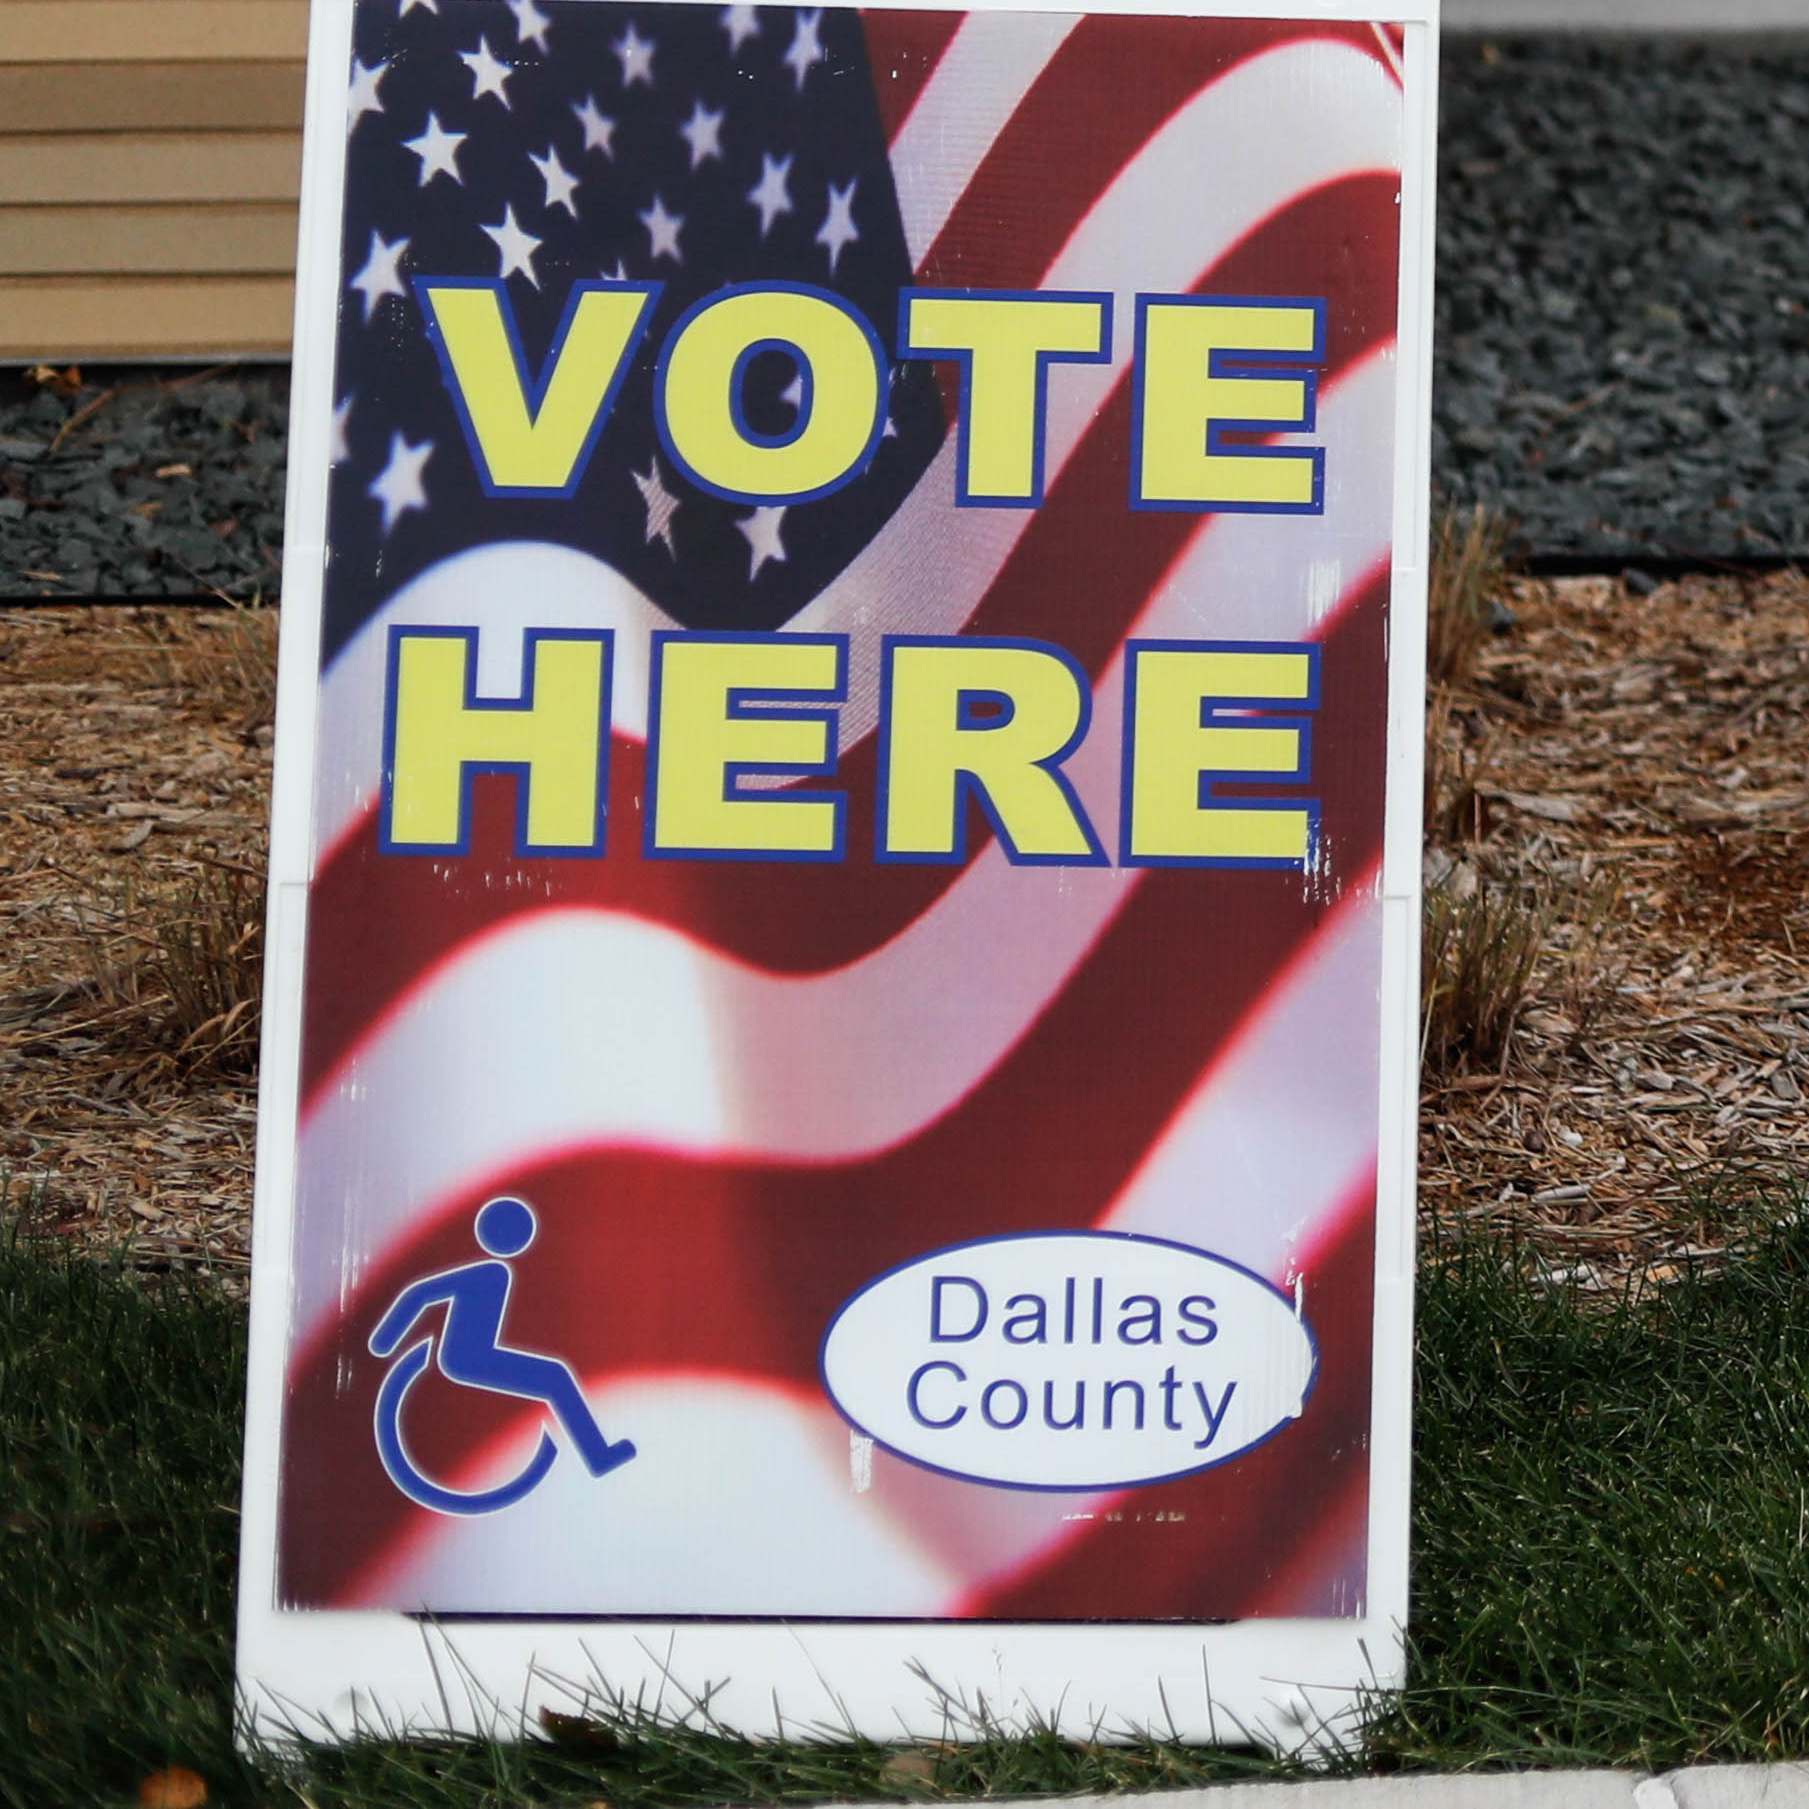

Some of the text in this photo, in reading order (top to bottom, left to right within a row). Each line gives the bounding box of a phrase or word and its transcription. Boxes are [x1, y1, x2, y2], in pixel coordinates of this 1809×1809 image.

[413, 276, 1327, 515] VOTE
[379, 624, 1322, 870] HERE
[929, 1275, 1219, 1346] Dallas
[906, 1359, 1238, 1449] County
